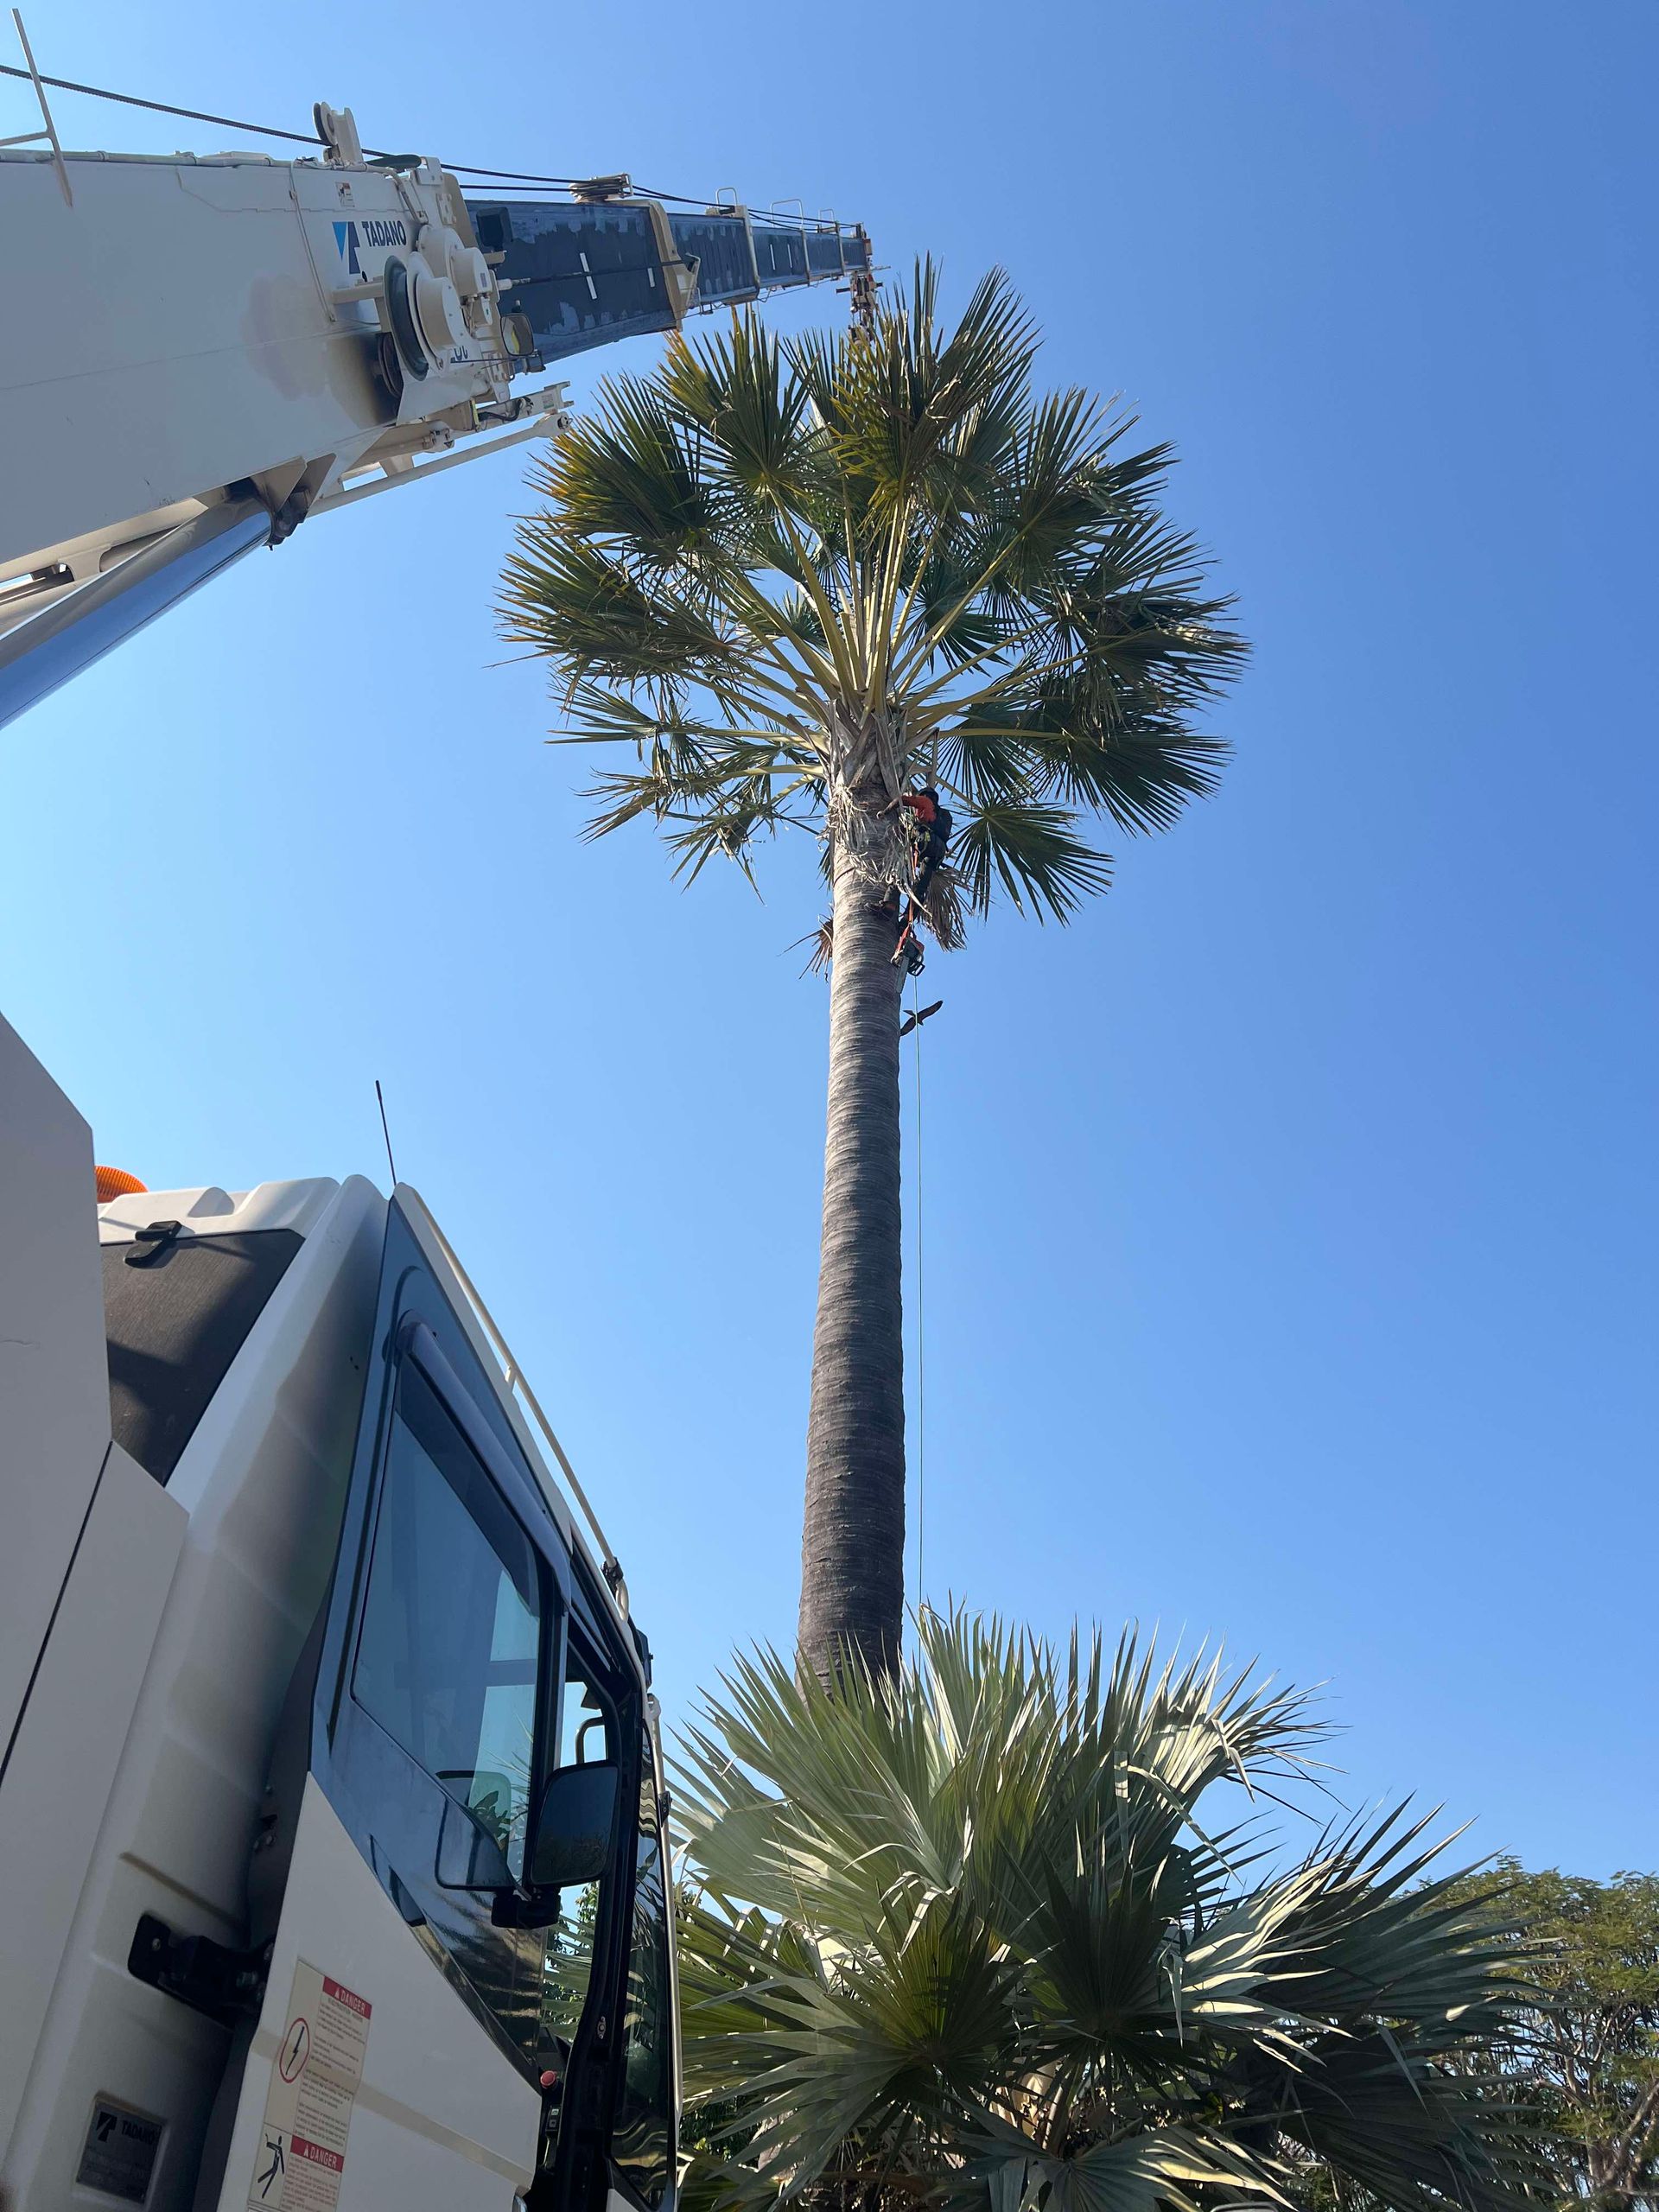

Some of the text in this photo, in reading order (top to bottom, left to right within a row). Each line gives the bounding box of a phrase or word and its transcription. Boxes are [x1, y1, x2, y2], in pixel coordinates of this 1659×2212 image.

[361, 220, 407, 247] TADANO
[340, 1990, 366, 2015] DANGER
[310, 2146, 337, 2169] DANGER
